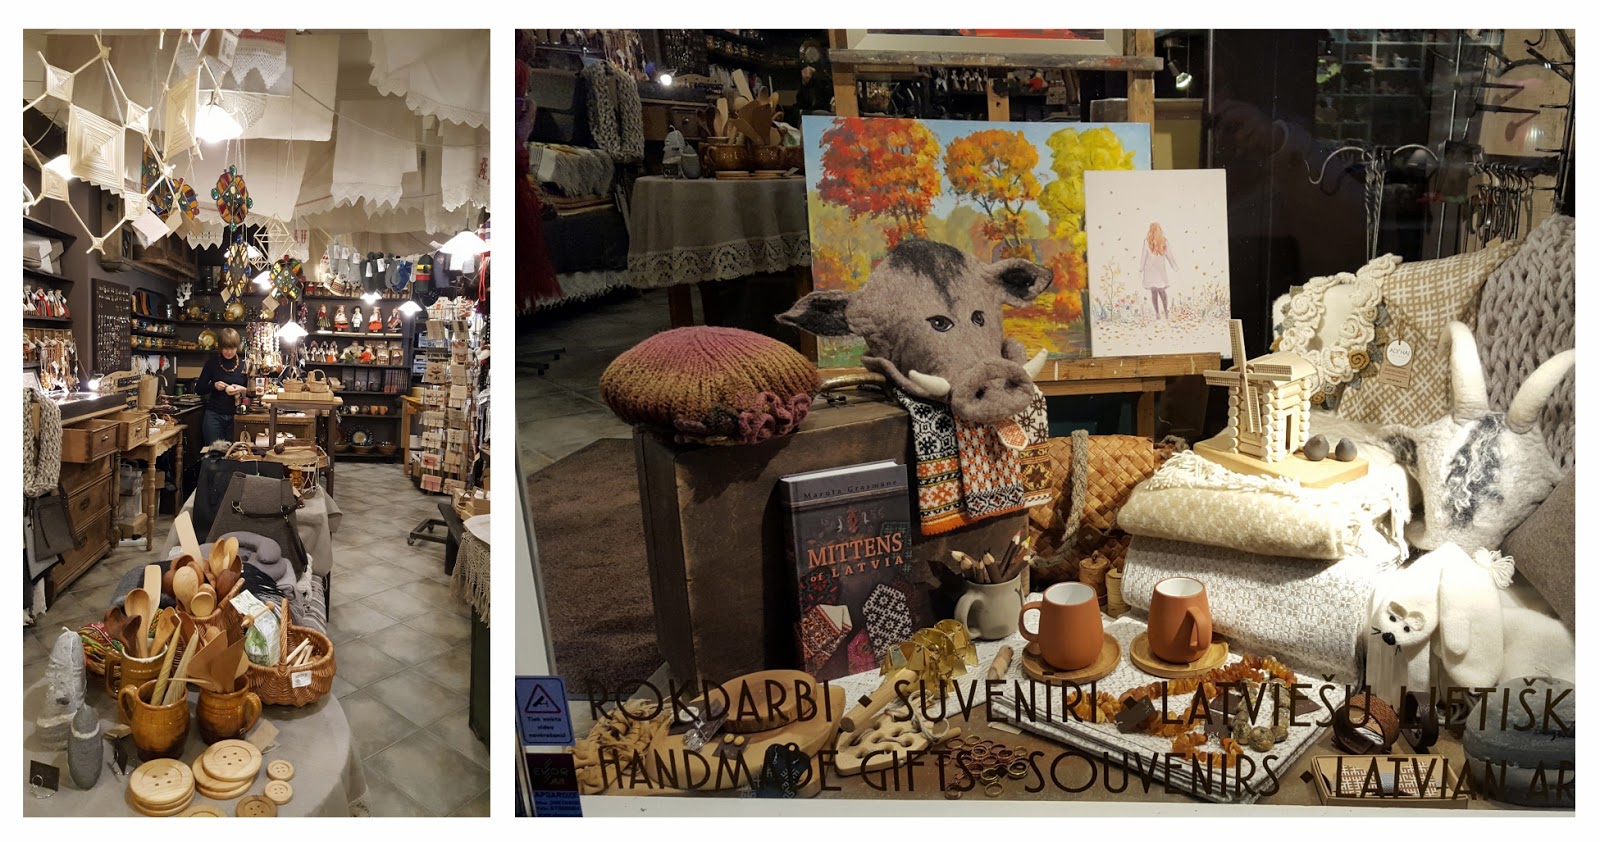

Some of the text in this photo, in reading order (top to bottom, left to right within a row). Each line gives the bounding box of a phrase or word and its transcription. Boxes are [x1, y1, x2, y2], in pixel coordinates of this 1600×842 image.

[803, 480, 898, 500] Maruta Grasmane
[808, 532, 904, 569] MITTENS
[811, 555, 904, 583] of LATVIA
[586, 679, 832, 723] ROKDARBI
[893, 671, 1097, 723] SUVENĪRI
[1161, 673, 1372, 728] LATVIEŠU
[860, 750, 976, 793] GIFTS
[1024, 750, 1280, 797] SOUVENIRS
[1336, 756, 1506, 801] LATVIAN
